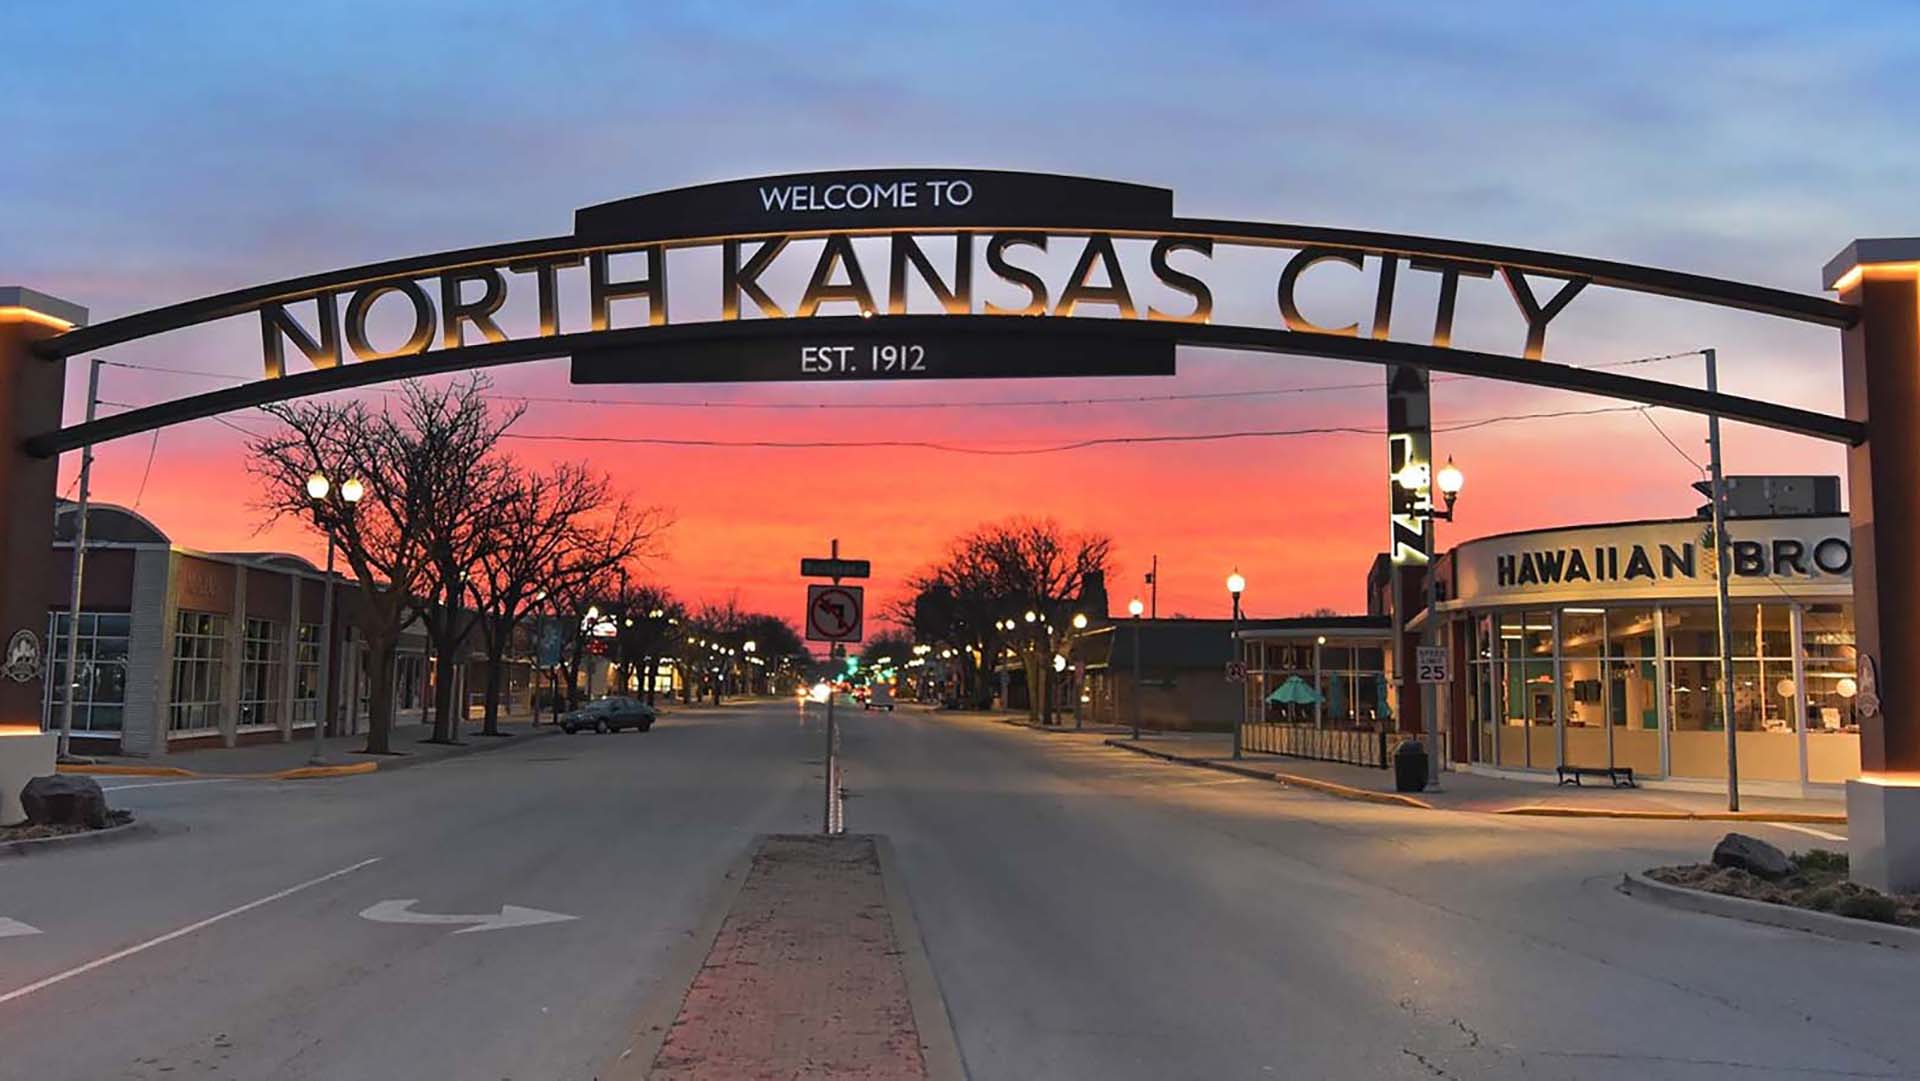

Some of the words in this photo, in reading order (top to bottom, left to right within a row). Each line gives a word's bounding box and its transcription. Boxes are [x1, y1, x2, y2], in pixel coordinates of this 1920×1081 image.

[759, 182, 917, 211] WELCOME
[926, 180, 973, 207] TO
[260, 244, 669, 379] NORTH
[721, 231, 1214, 324] KANSAS
[1277, 246, 1592, 362] CITY
[801, 346, 857, 372] EST.
[872, 345, 927, 371] 1912
[1498, 543, 1696, 586] HAWAIIAN
[1733, 537, 1851, 577] BRO
[1420, 665, 1445, 680] 25
